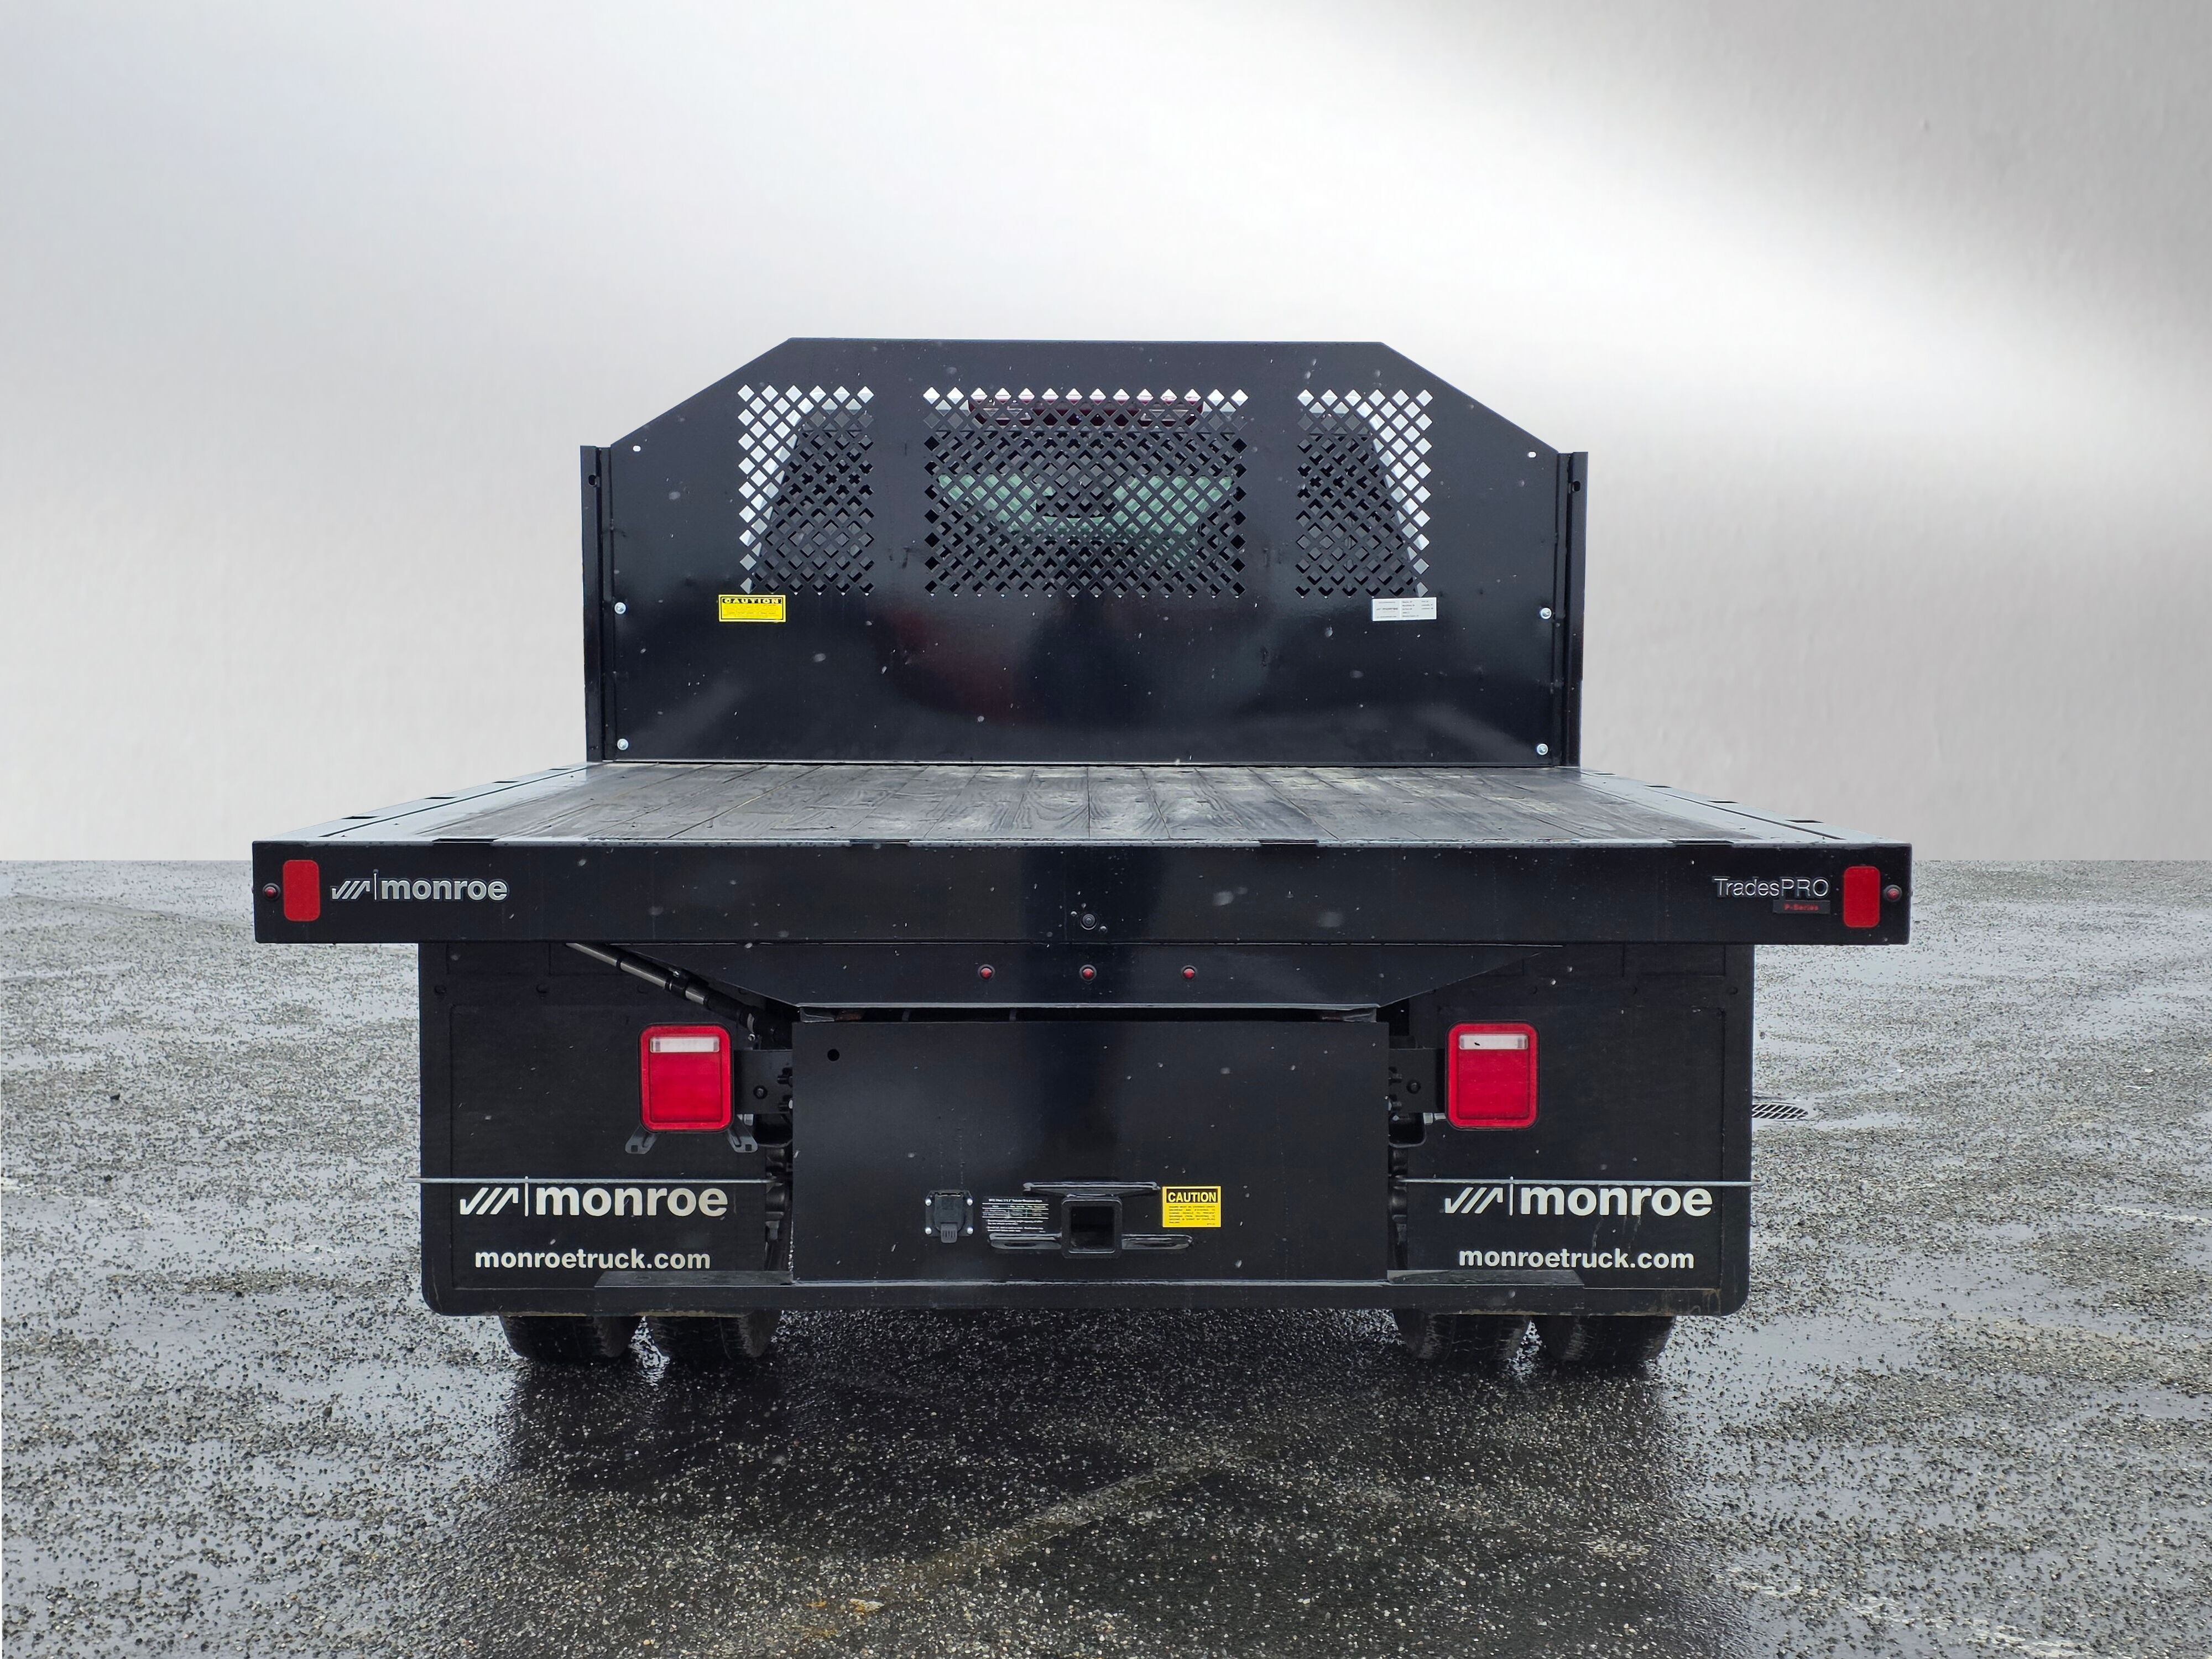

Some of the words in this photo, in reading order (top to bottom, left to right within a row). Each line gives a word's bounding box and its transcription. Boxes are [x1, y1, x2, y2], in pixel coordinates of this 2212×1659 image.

[382, 880, 508, 900] monroe
[1714, 878, 1829, 896] TradesPRO
[536, 1187, 728, 1217] monroe
[1168, 1192, 1217, 1202] CAUTION
[1521, 1187, 1713, 1217] monroe
[475, 1249, 711, 1269] monroetruck.com
[1459, 1248, 1694, 1269] monroetruck.com
